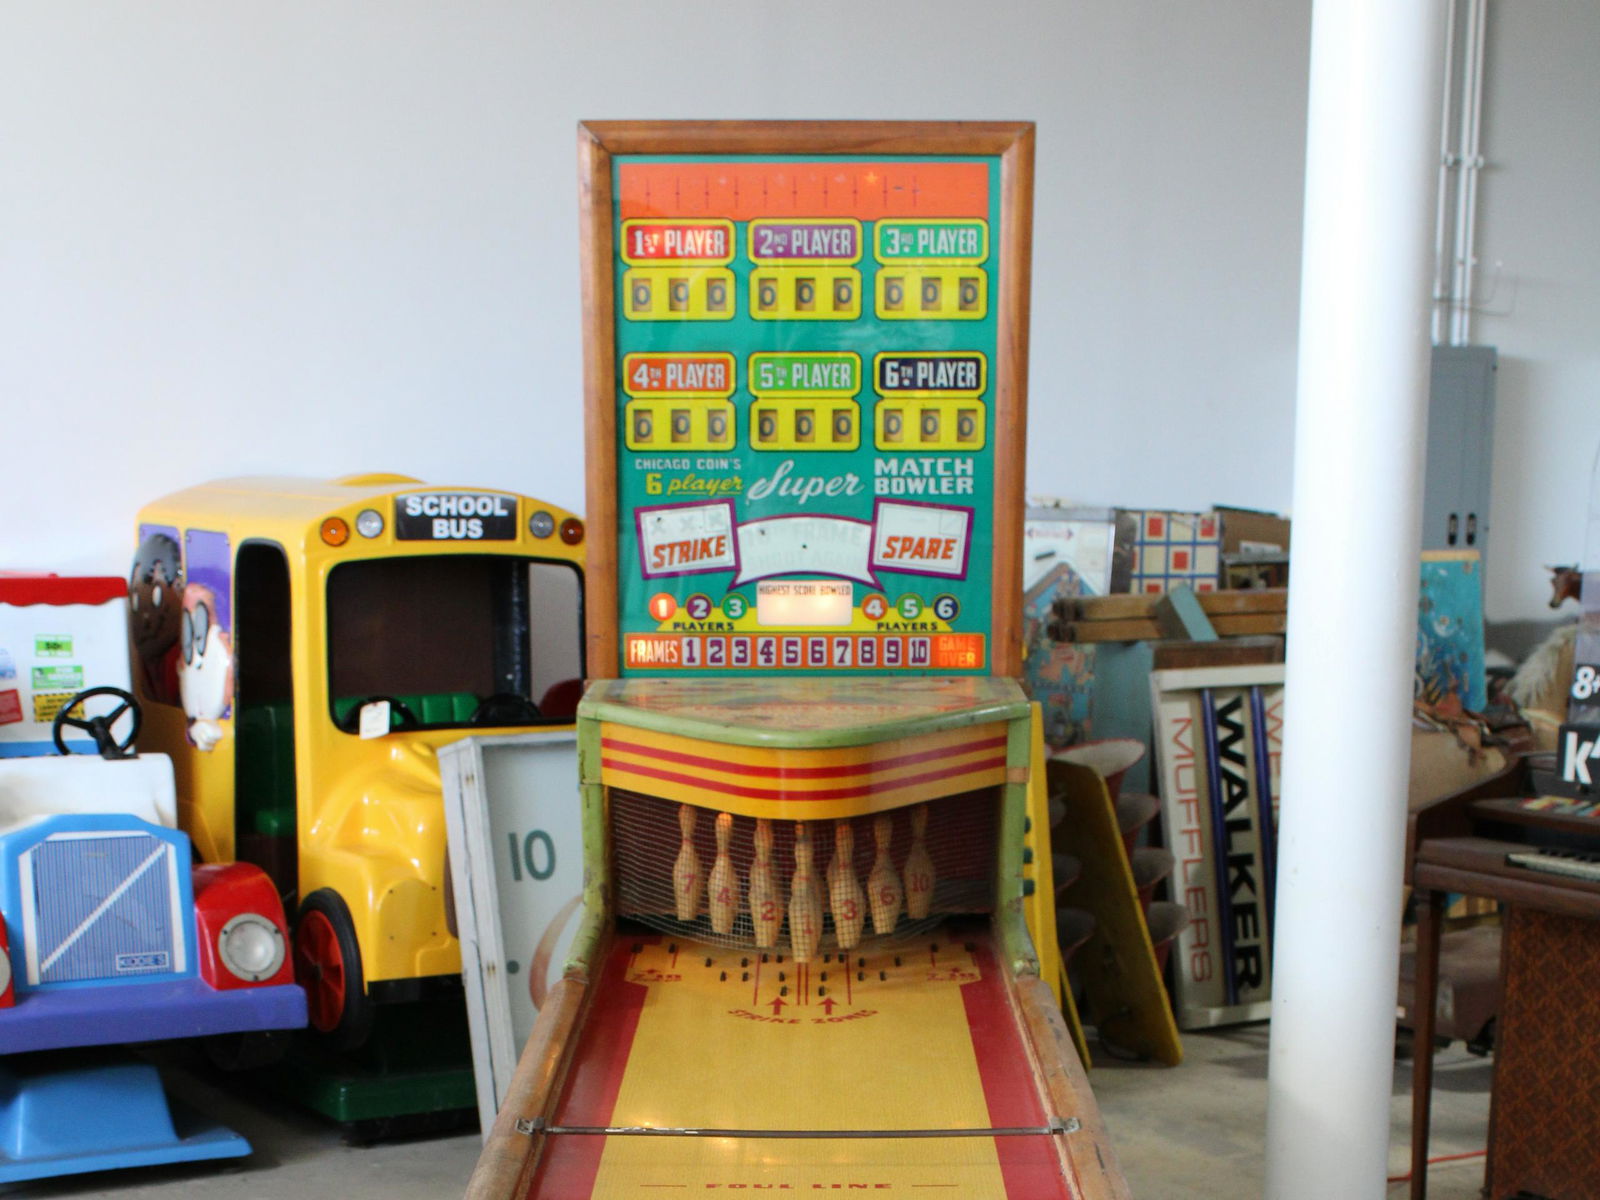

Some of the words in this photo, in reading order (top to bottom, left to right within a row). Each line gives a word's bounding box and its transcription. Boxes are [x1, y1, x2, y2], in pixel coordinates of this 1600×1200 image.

[664, 229, 725, 256] PLAYER
[791, 228, 852, 255] PLAYER
[917, 228, 978, 254] PLAYER
[666, 363, 725, 388] PLAYER
[792, 363, 851, 388] PLAYER
[917, 361, 977, 387] PLAYER
[635, 458, 690, 470] CHICAGO
[696, 458, 742, 470] COIN'S
[874, 457, 975, 477] MATCH
[646, 472, 663, 495] 6
[667, 473, 744, 496] player
[746, 460, 865, 506] Super
[874, 477, 974, 495] BOWLER
[405, 496, 509, 517] SCHOOL
[432, 518, 484, 539] BUS
[652, 535, 727, 569] STRIKE
[883, 536, 957, 560] SPARE
[657, 598, 667, 617] 1
[693, 598, 707, 617] 2
[729, 598, 742, 617] 3
[865, 598, 883, 618] 4
[903, 598, 919, 618] 5
[937, 598, 954, 618] 6
[673, 622, 735, 631] PLAYERS
[877, 622, 938, 631] PLAYERS
[630, 640, 678, 663] FRAMES
[686, 639, 696, 664] 1
[709, 639, 723, 664] 2
[735, 639, 748, 664] 3
[760, 639, 773, 664] 4
[785, 639, 798, 664] 5
[810, 639, 824, 664] 6
[836, 639, 849, 664] 7
[861, 639, 874, 664] 8
[886, 639, 899, 664] 9
[911, 639, 927, 664] 10
[938, 637, 976, 651] GAME
[938, 652, 976, 667] OVER
[1171, 716, 1213, 983] MUFFLERS
[1215, 695, 1263, 991] WALKER
[508, 829, 556, 882] 10
[683, 873, 696, 894] 7
[717, 887, 731, 906] 4
[761, 901, 776, 921] 2
[842, 900, 857, 921] 3
